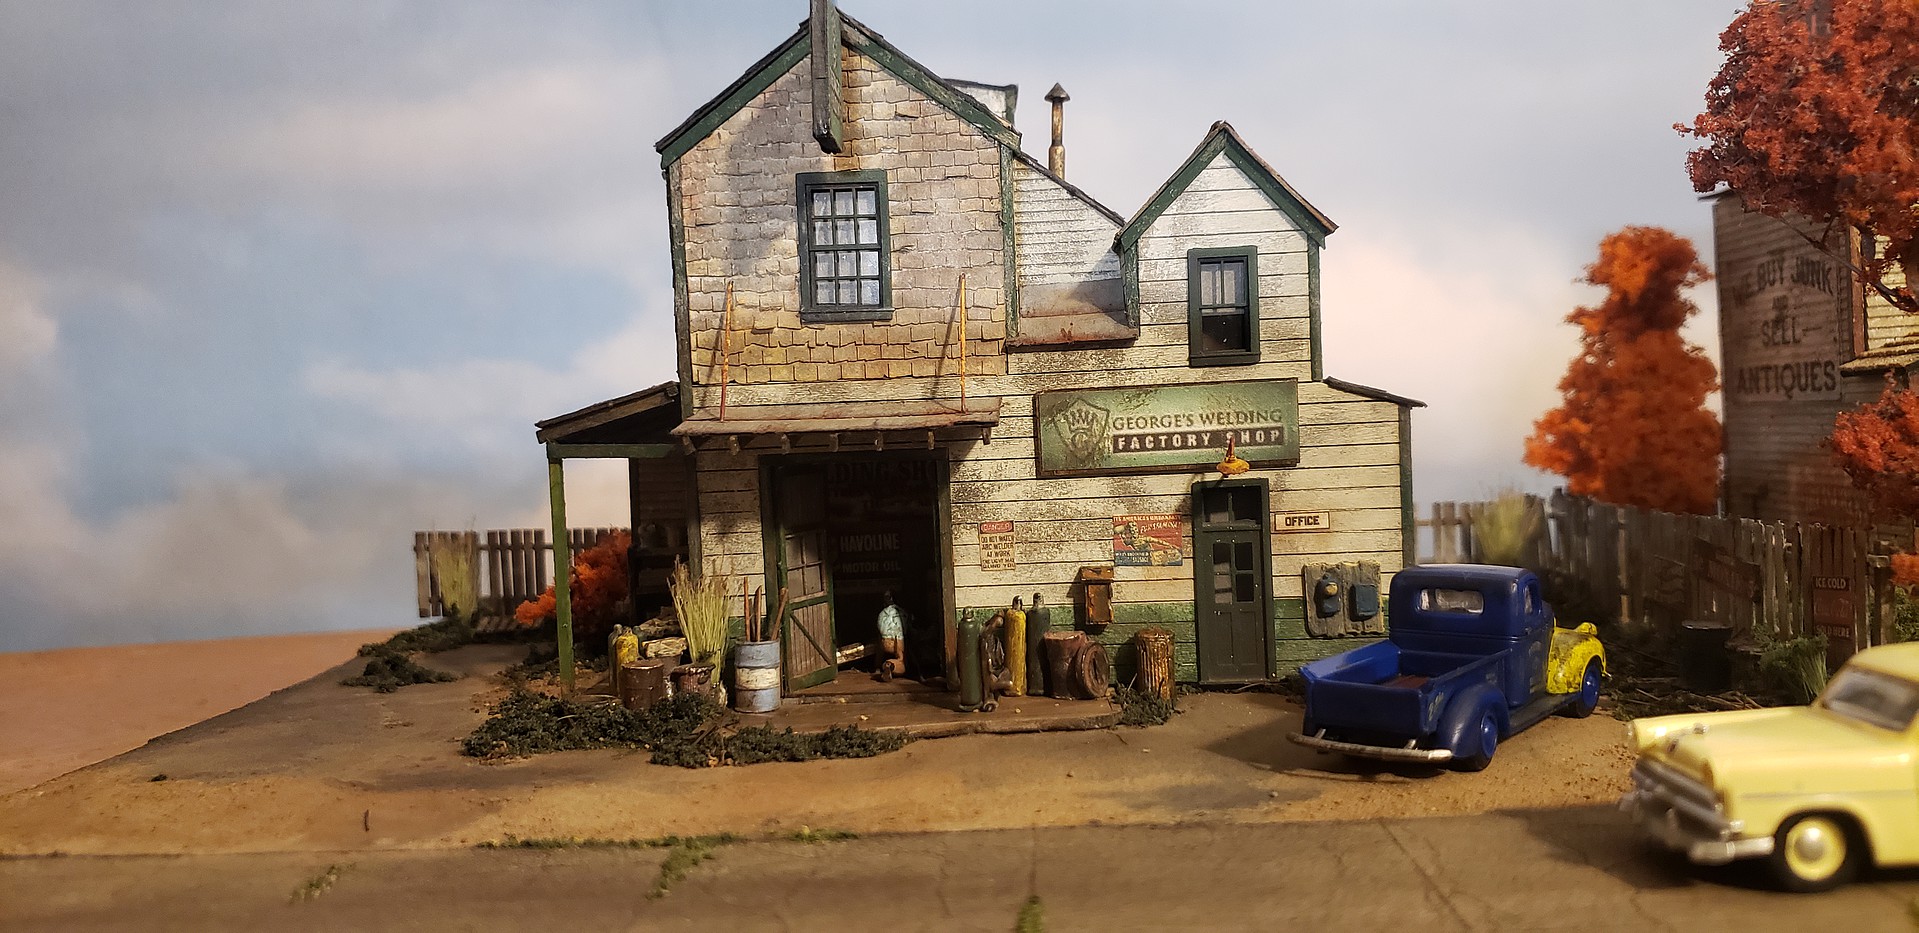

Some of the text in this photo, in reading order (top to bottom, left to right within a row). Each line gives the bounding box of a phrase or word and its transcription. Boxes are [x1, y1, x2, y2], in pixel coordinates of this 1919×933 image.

[1757, 255, 1785, 292] BUY
[1791, 256, 1835, 297] JUNK
[1762, 317, 1801, 347] SELL
[1737, 360, 1837, 400] ANTIQUES
[1112, 408, 1283, 430] GEORGE'S WELDING
[1117, 430, 1280, 450] FACTORY SHOP
[1285, 515, 1320, 527] OFFICE
[840, 533, 900, 553] HAVOLINE
[993, 542, 1014, 550] WELDER
[842, 560, 902, 574] MOTOR OIL
[1815, 577, 1847, 590] ICE COLD
[1833, 626, 1850, 638] HERE
